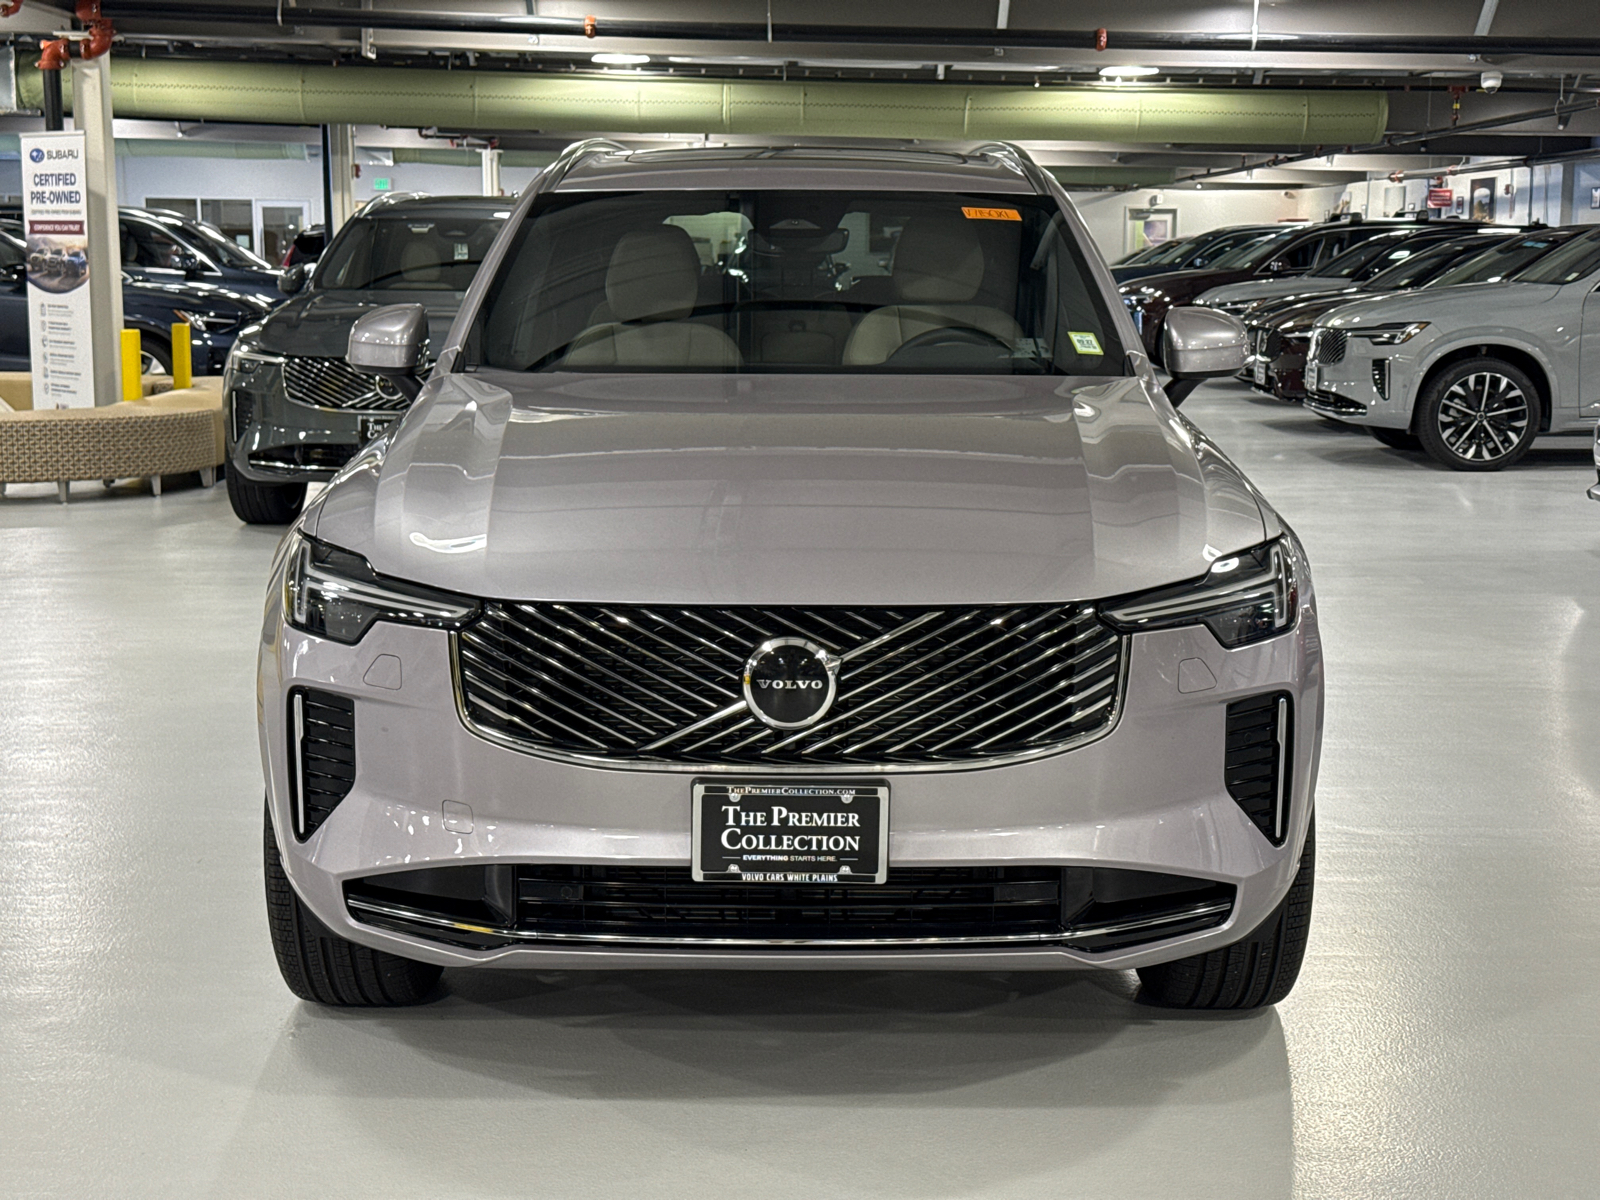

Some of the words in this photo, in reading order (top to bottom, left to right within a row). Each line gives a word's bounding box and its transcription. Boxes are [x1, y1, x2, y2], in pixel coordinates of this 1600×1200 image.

[46, 149, 79, 159] SUBARU
[33, 172, 76, 186] CERTIFIED
[31, 190, 81, 205] PRE-OWNED
[756, 679, 823, 690] VOLVO
[721, 805, 767, 826] THE
[771, 806, 861, 827] PREMIER
[721, 828, 861, 851] COLLECTION
[742, 873, 764, 881] VOLVO
[766, 873, 785, 881] CARS
[787, 874, 810, 882] WHITE
[812, 874, 838, 882] PLAINS
